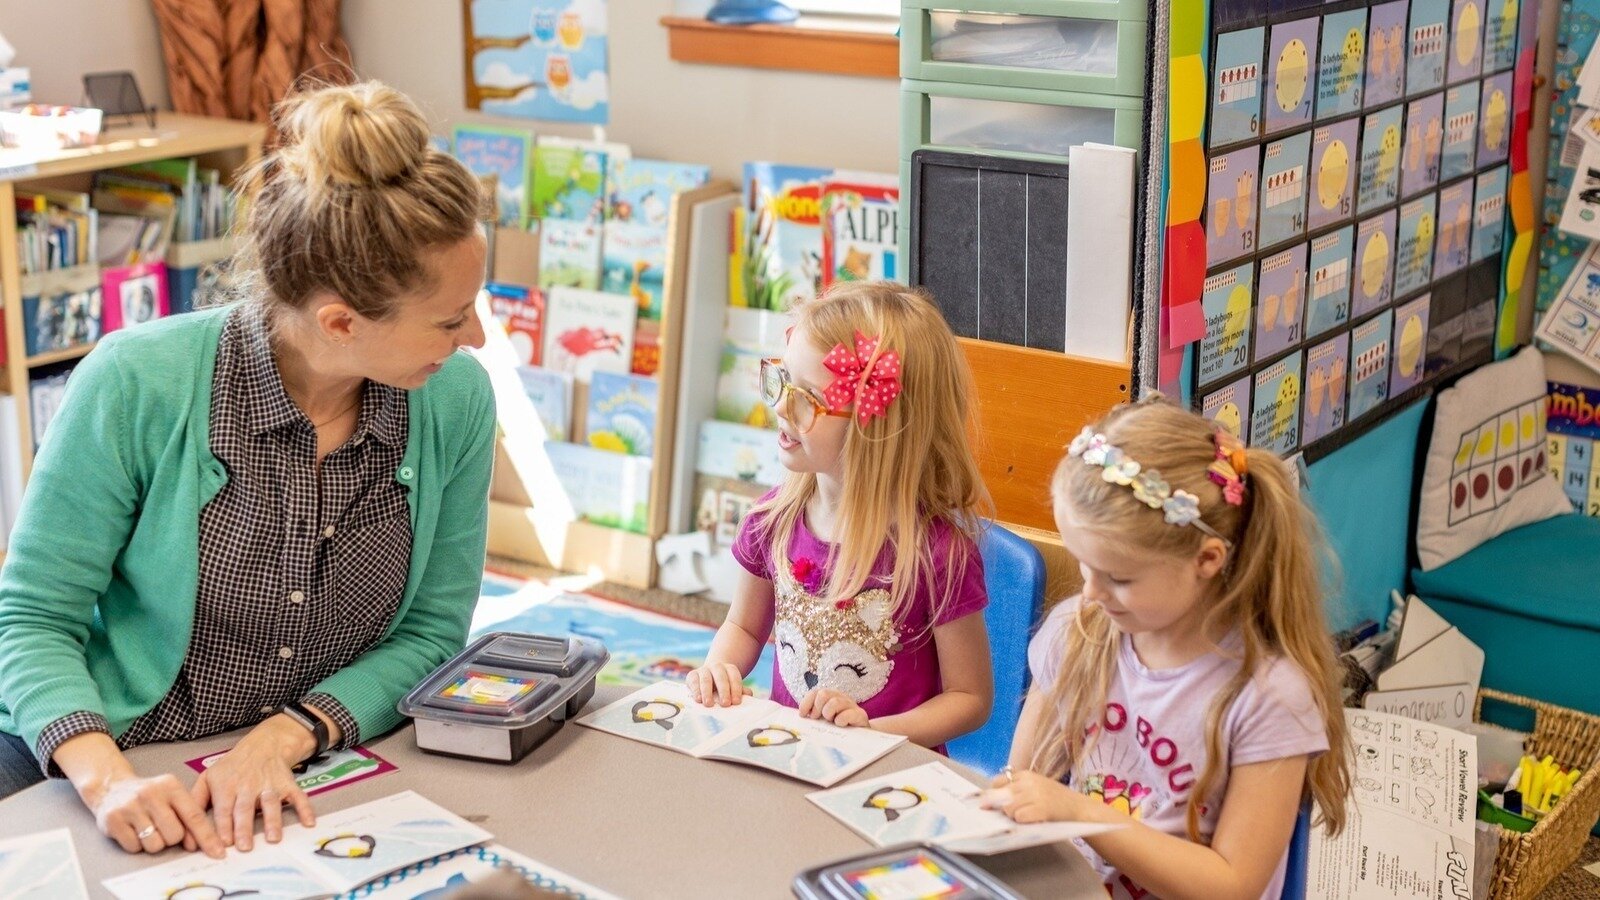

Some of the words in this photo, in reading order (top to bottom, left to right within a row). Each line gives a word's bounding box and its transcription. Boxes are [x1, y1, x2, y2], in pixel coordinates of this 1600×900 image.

[1327, 52, 1348, 63] ladybugs
[1321, 79, 1332, 87] How
[1346, 73, 1358, 82] more
[1433, 66, 1443, 83] 10
[1395, 77, 1401, 94] 9
[1353, 88, 1359, 105] 8
[1304, 101, 1311, 119] 7
[1250, 113, 1257, 132] 6
[1386, 181, 1395, 199] 16
[1340, 197, 1350, 215] 15
[1292, 213, 1302, 231] 14
[1242, 231, 1253, 249] 13
[1379, 284, 1389, 302] 23
[1208, 310, 1233, 329] ladybugs
[1335, 303, 1347, 321] 22
[1216, 322, 1227, 336] leaf
[1288, 324, 1299, 342] 21
[1203, 341, 1216, 351] How
[1216, 335, 1231, 347] many
[1231, 329, 1245, 341] more
[1202, 355, 1209, 364] to
[1209, 348, 1224, 361] make
[1224, 345, 1233, 355] the
[1233, 344, 1247, 366] 20
[1202, 364, 1214, 376] next
[1215, 358, 1224, 370] 10?
[1414, 363, 1423, 381] 31
[1376, 382, 1386, 400] 30
[1260, 399, 1283, 417] ladybugs
[1255, 422, 1263, 430] on
[1267, 411, 1277, 423] leaf
[1332, 408, 1342, 427] 29
[1255, 431, 1267, 440] How
[1267, 422, 1281, 434] many
[1281, 414, 1294, 426] more
[1283, 427, 1296, 449] 28
[1550, 441, 1559, 455] 3
[1574, 444, 1584, 459] 4
[1569, 472, 1584, 489] 14
[1459, 749, 1468, 768] Short
[1459, 770, 1468, 793] Vowel
[1458, 793, 1468, 823] Review
[1446, 851, 1471, 900] FUN
